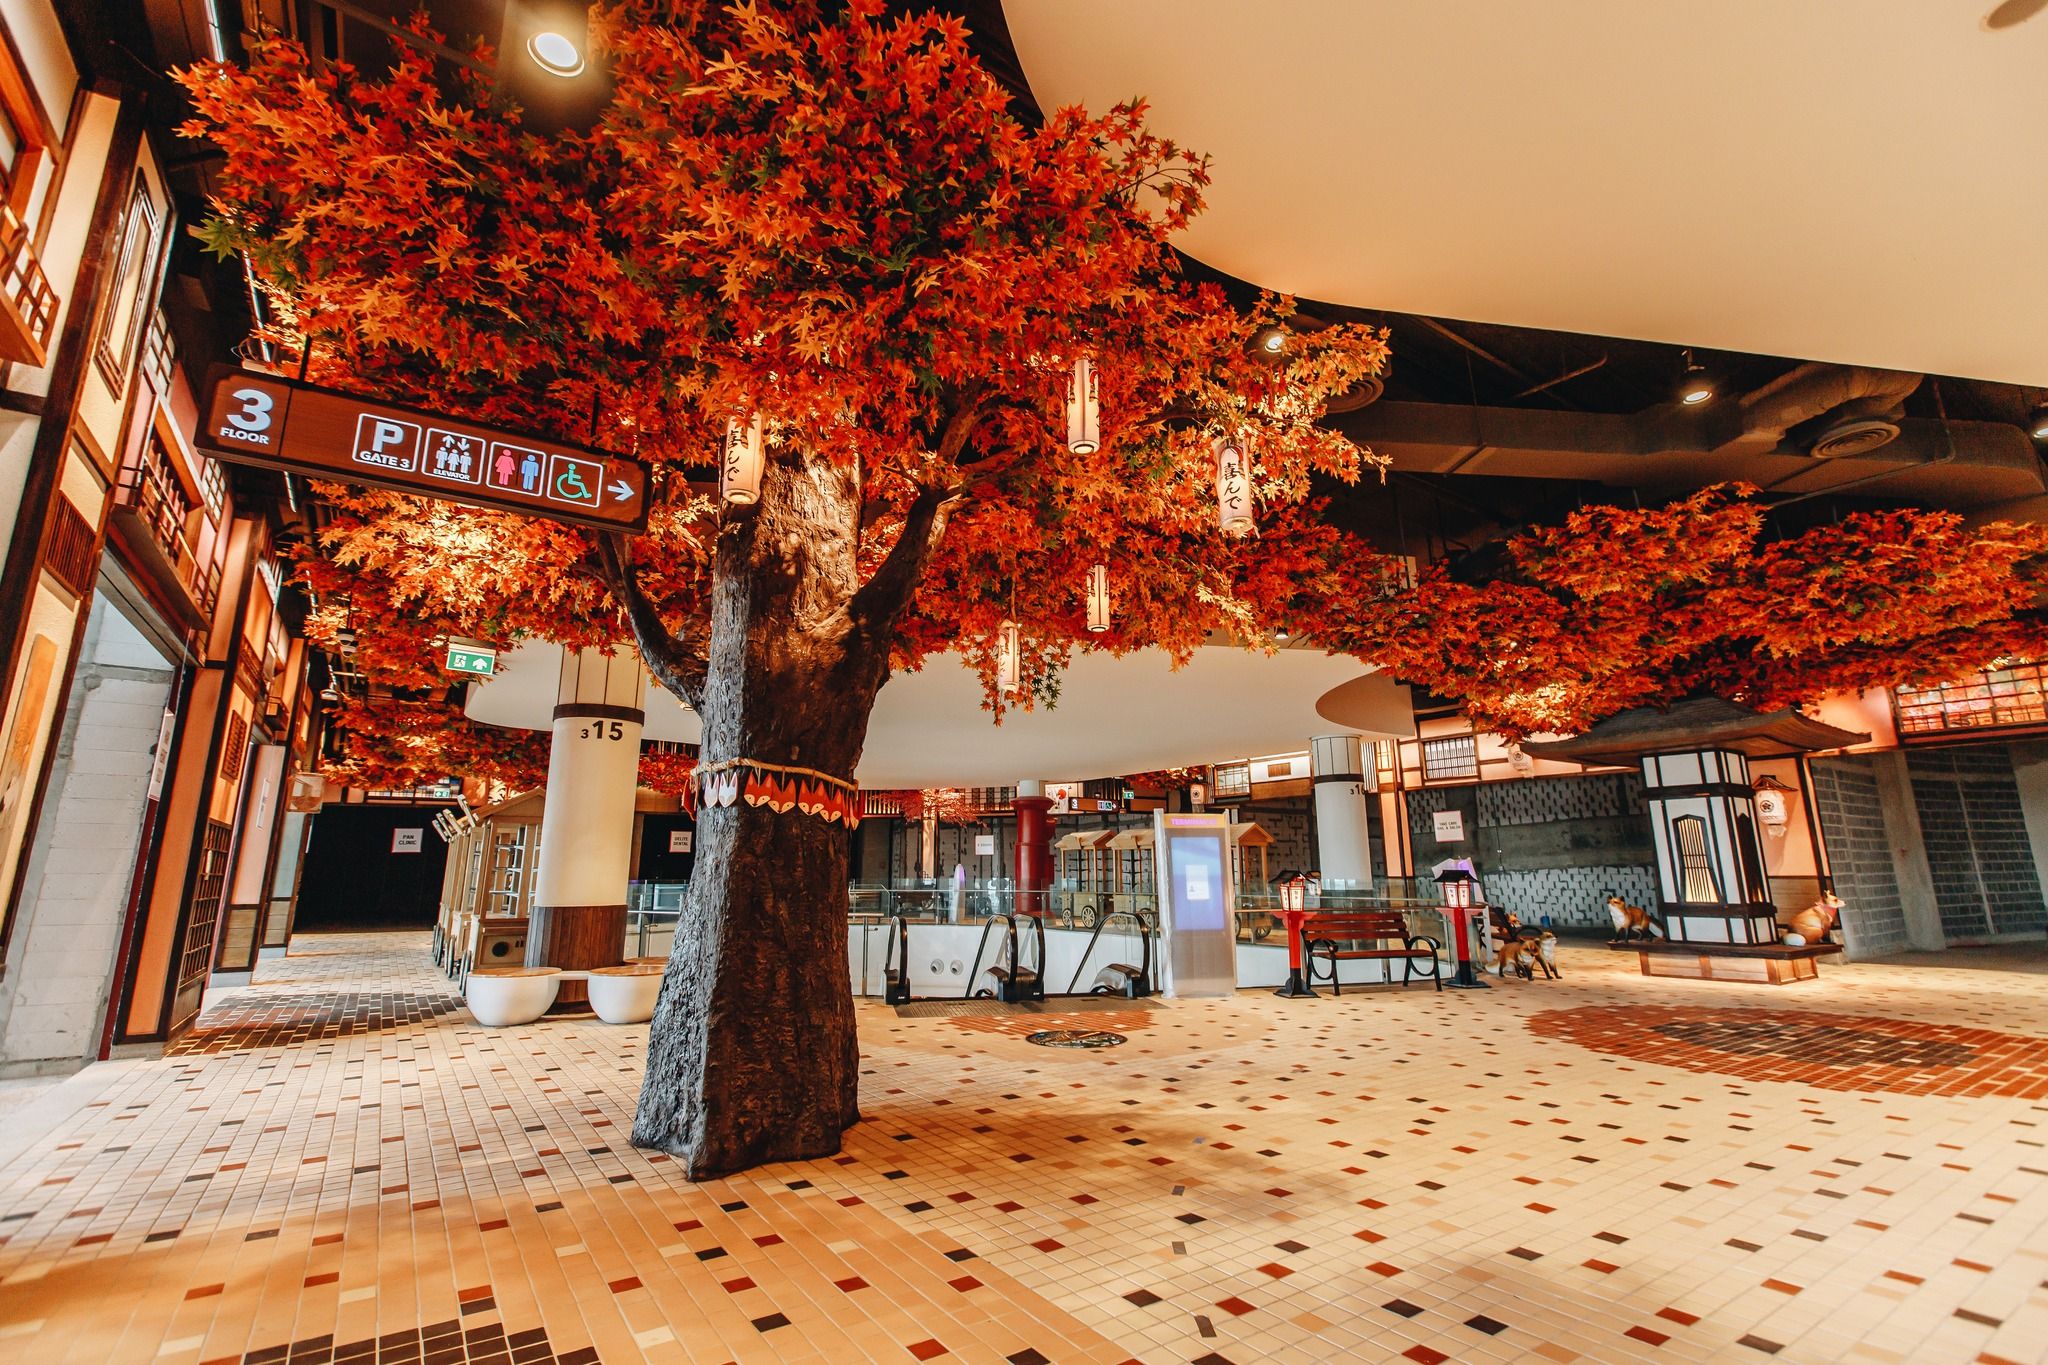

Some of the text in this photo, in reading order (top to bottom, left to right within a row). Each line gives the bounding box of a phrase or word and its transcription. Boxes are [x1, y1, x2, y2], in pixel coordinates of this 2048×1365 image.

[226, 388, 273, 431] 3
[220, 426, 270, 445] FLOOR
[372, 421, 404, 453] P
[359, 450, 411, 469] GATE 3
[433, 468, 471, 481] ELEVATOR
